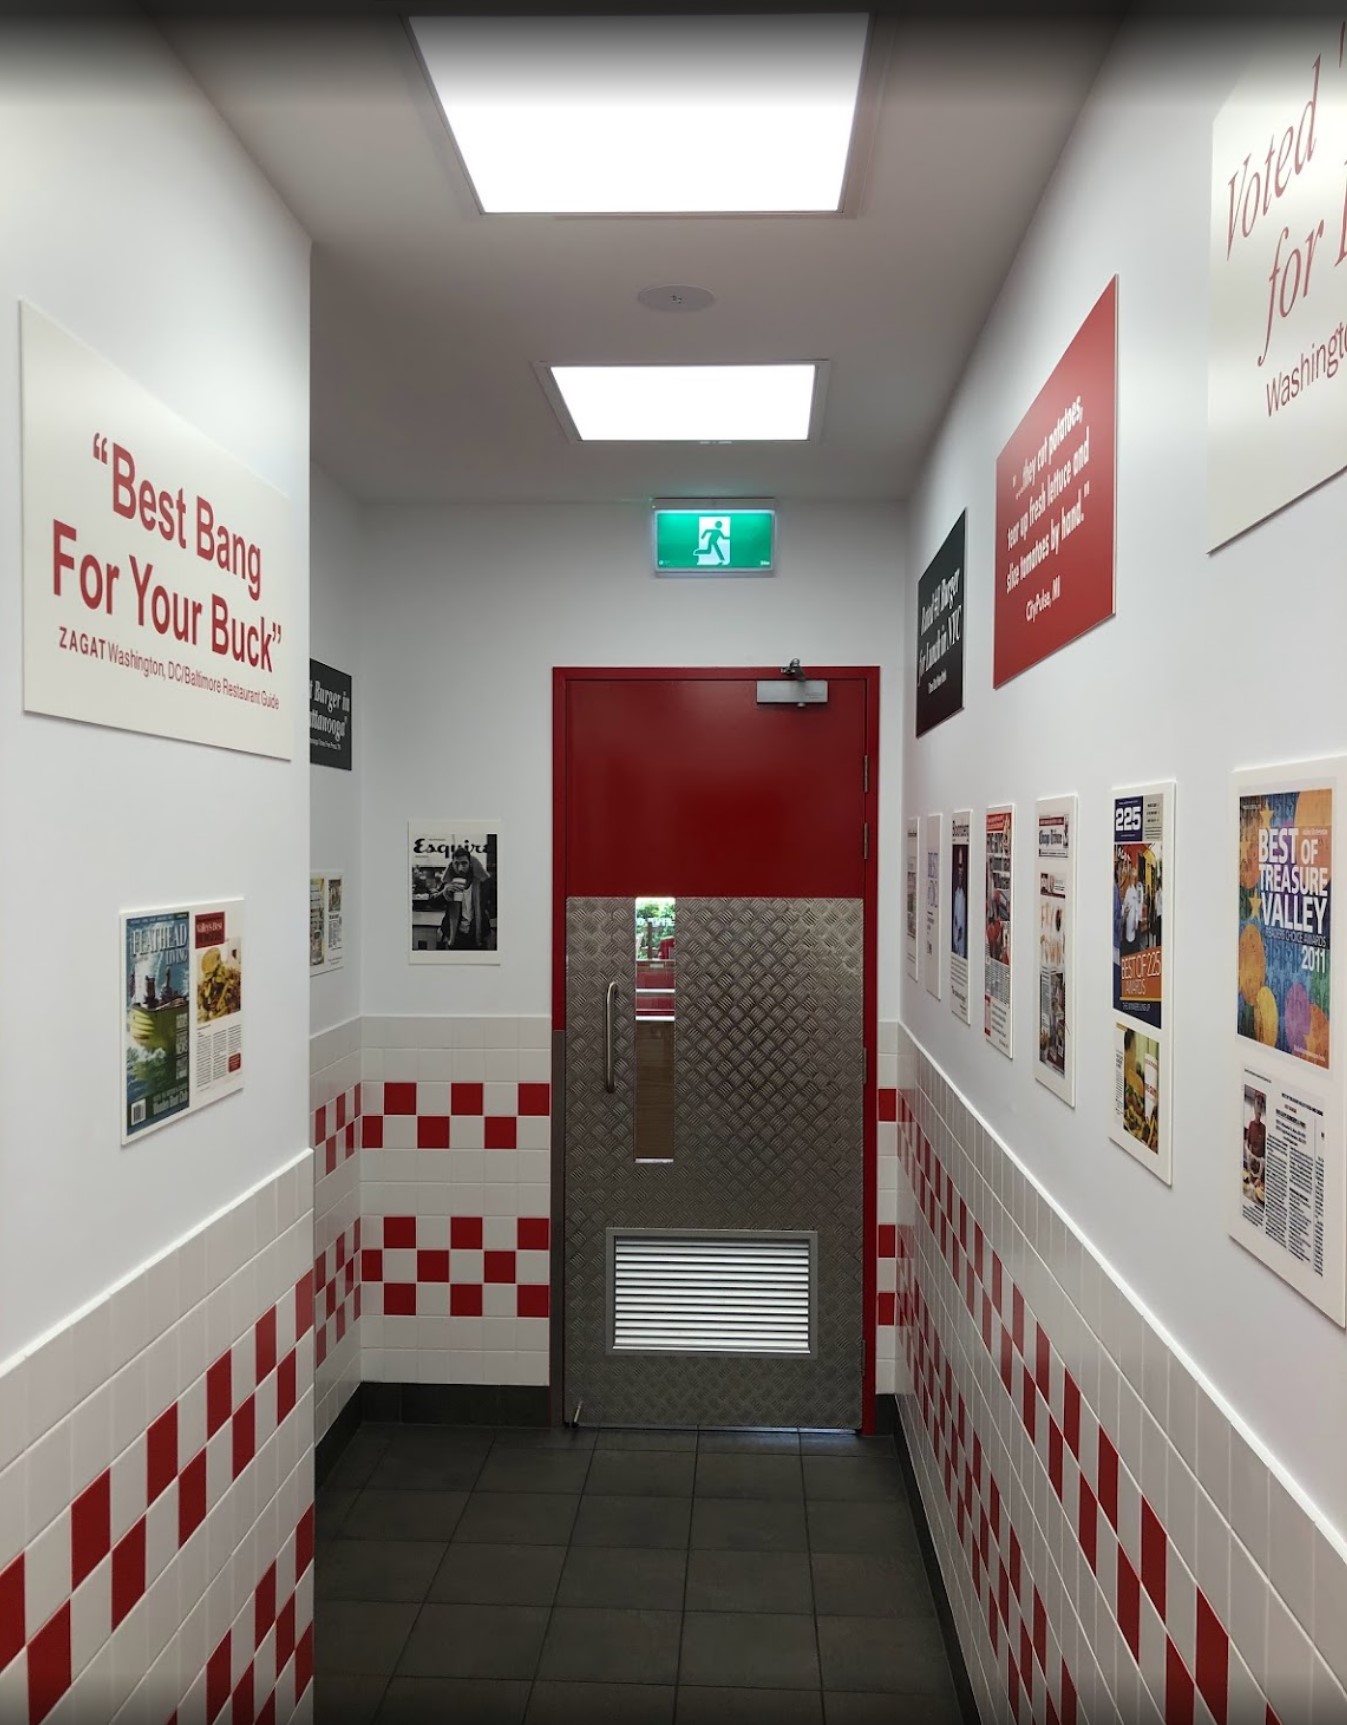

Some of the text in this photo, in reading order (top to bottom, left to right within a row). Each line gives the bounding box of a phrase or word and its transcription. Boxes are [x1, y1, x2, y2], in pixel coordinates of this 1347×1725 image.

[1226, 53, 1321, 261] Voted
[1257, 220, 1325, 367] for
[1266, 321, 1347, 418] Washingt
[1037, 436, 1048, 472] cut
[1048, 395, 1084, 466] potatoes,
[1020, 511, 1029, 541] up
[1029, 482, 1047, 528] fresh
[1047, 459, 1072, 508] lettuce
[1072, 424, 1090, 478] and
[196, 495, 262, 602] Bang
[1006, 562, 1020, 594] slice
[1020, 533, 1050, 582] tomatoes
[1050, 518, 1060, 555] by
[52, 518, 120, 615] For
[129, 554, 203, 646] Your
[940, 568, 960, 613] Burger
[947, 604, 962, 650] NYC
[59, 627, 106, 661] ZAGAT
[107, 641, 166, 681] Washington,
[168, 662, 222, 695] DC/Baltimore
[223, 677, 260, 705] Restaurant
[261, 690, 280, 710] Guide
[314, 680, 341, 713] Burger
[342, 691, 350, 712] in
[1115, 806, 1142, 831] 225
[1258, 827, 1319, 865] BEST OF
[1258, 864, 1329, 897] TREASURE
[1261, 892, 1328, 935] VALLEY
[133, 922, 188, 956] FLATHEAD
[1301, 944, 1326, 974] 2011
[1122, 951, 1161, 980] BEST OF 225
